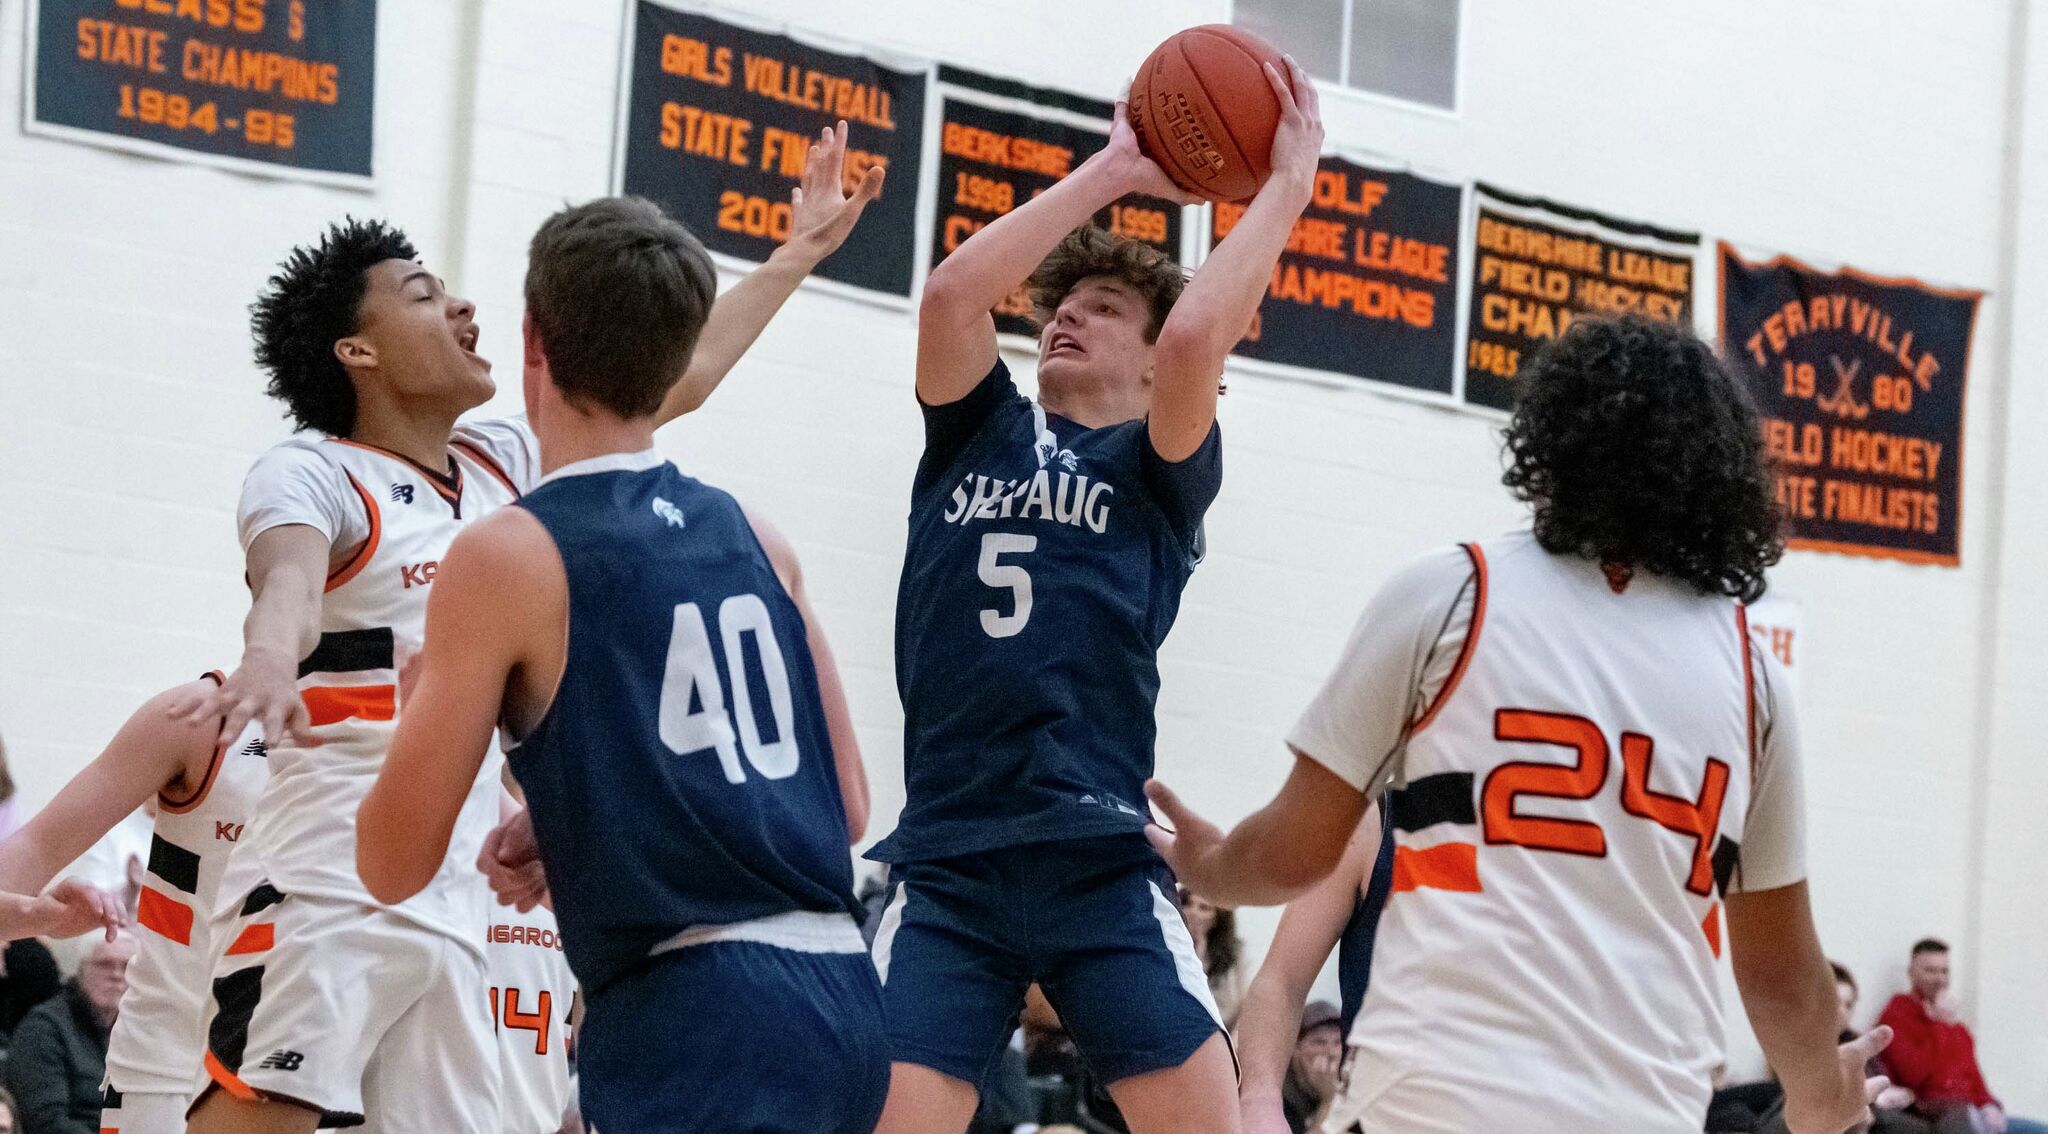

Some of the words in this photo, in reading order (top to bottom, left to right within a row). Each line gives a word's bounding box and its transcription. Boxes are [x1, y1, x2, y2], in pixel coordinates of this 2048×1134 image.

[77, 18, 167, 73] STATE
[182, 39, 338, 105] CHAMPIONS
[661, 34, 733, 86] GIRLS
[744, 52, 896, 131] VOLLEYBALL
[118, 84, 294, 148] 1994-95
[660, 102, 751, 166] STATE
[1158, 90, 1220, 181] LEGACY
[718, 190, 794, 243] 200
[1313, 170, 1388, 217] OLF
[1355, 228, 1448, 283] LEAGUE
[1480, 255, 1571, 303] FIELD
[1747, 295, 1940, 393] TERRYVILLE
[1831, 427, 1942, 481] HOCKEY
[1823, 479, 1940, 534] FINALISTS
[977, 532, 1038, 639] 5
[659, 594, 800, 784] 40
[1481, 707, 1730, 897] 24
